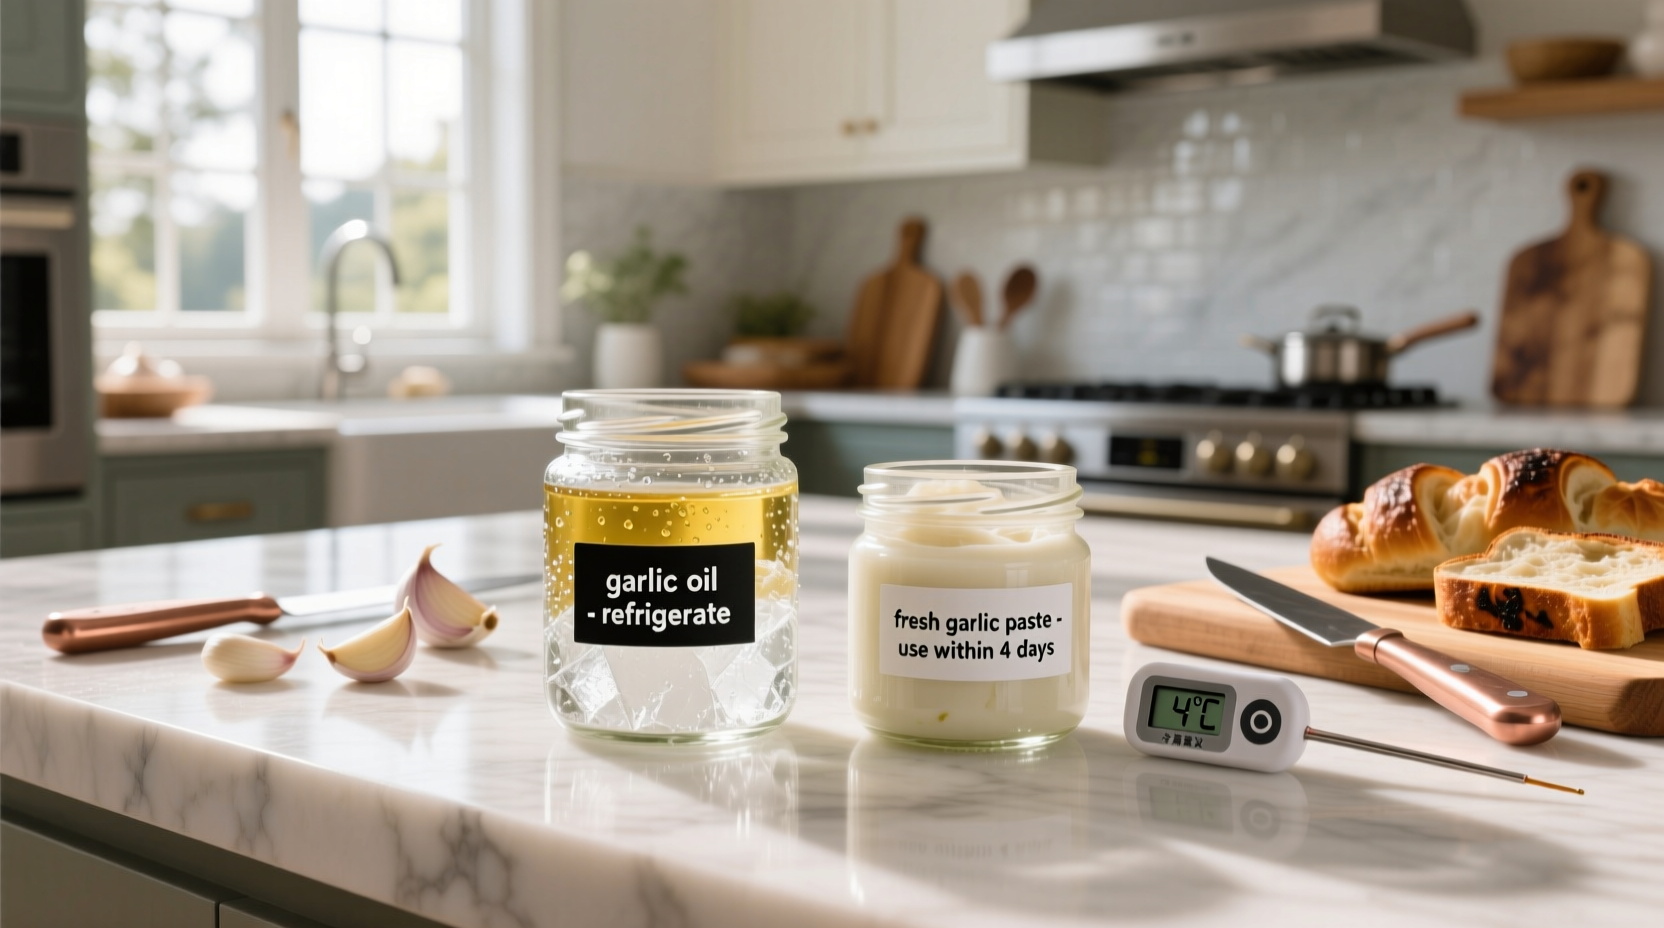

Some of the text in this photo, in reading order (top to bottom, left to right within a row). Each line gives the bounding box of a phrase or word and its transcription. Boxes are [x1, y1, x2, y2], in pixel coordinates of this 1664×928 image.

[605, 565, 717, 599] garlic oil
[602, 601, 731, 633] refrigerate
[893, 608, 940, 632] fresh
[945, 612, 1000, 637] garlic
[1005, 611, 1052, 636] paste
[898, 638, 1055, 663] use within 4 days
